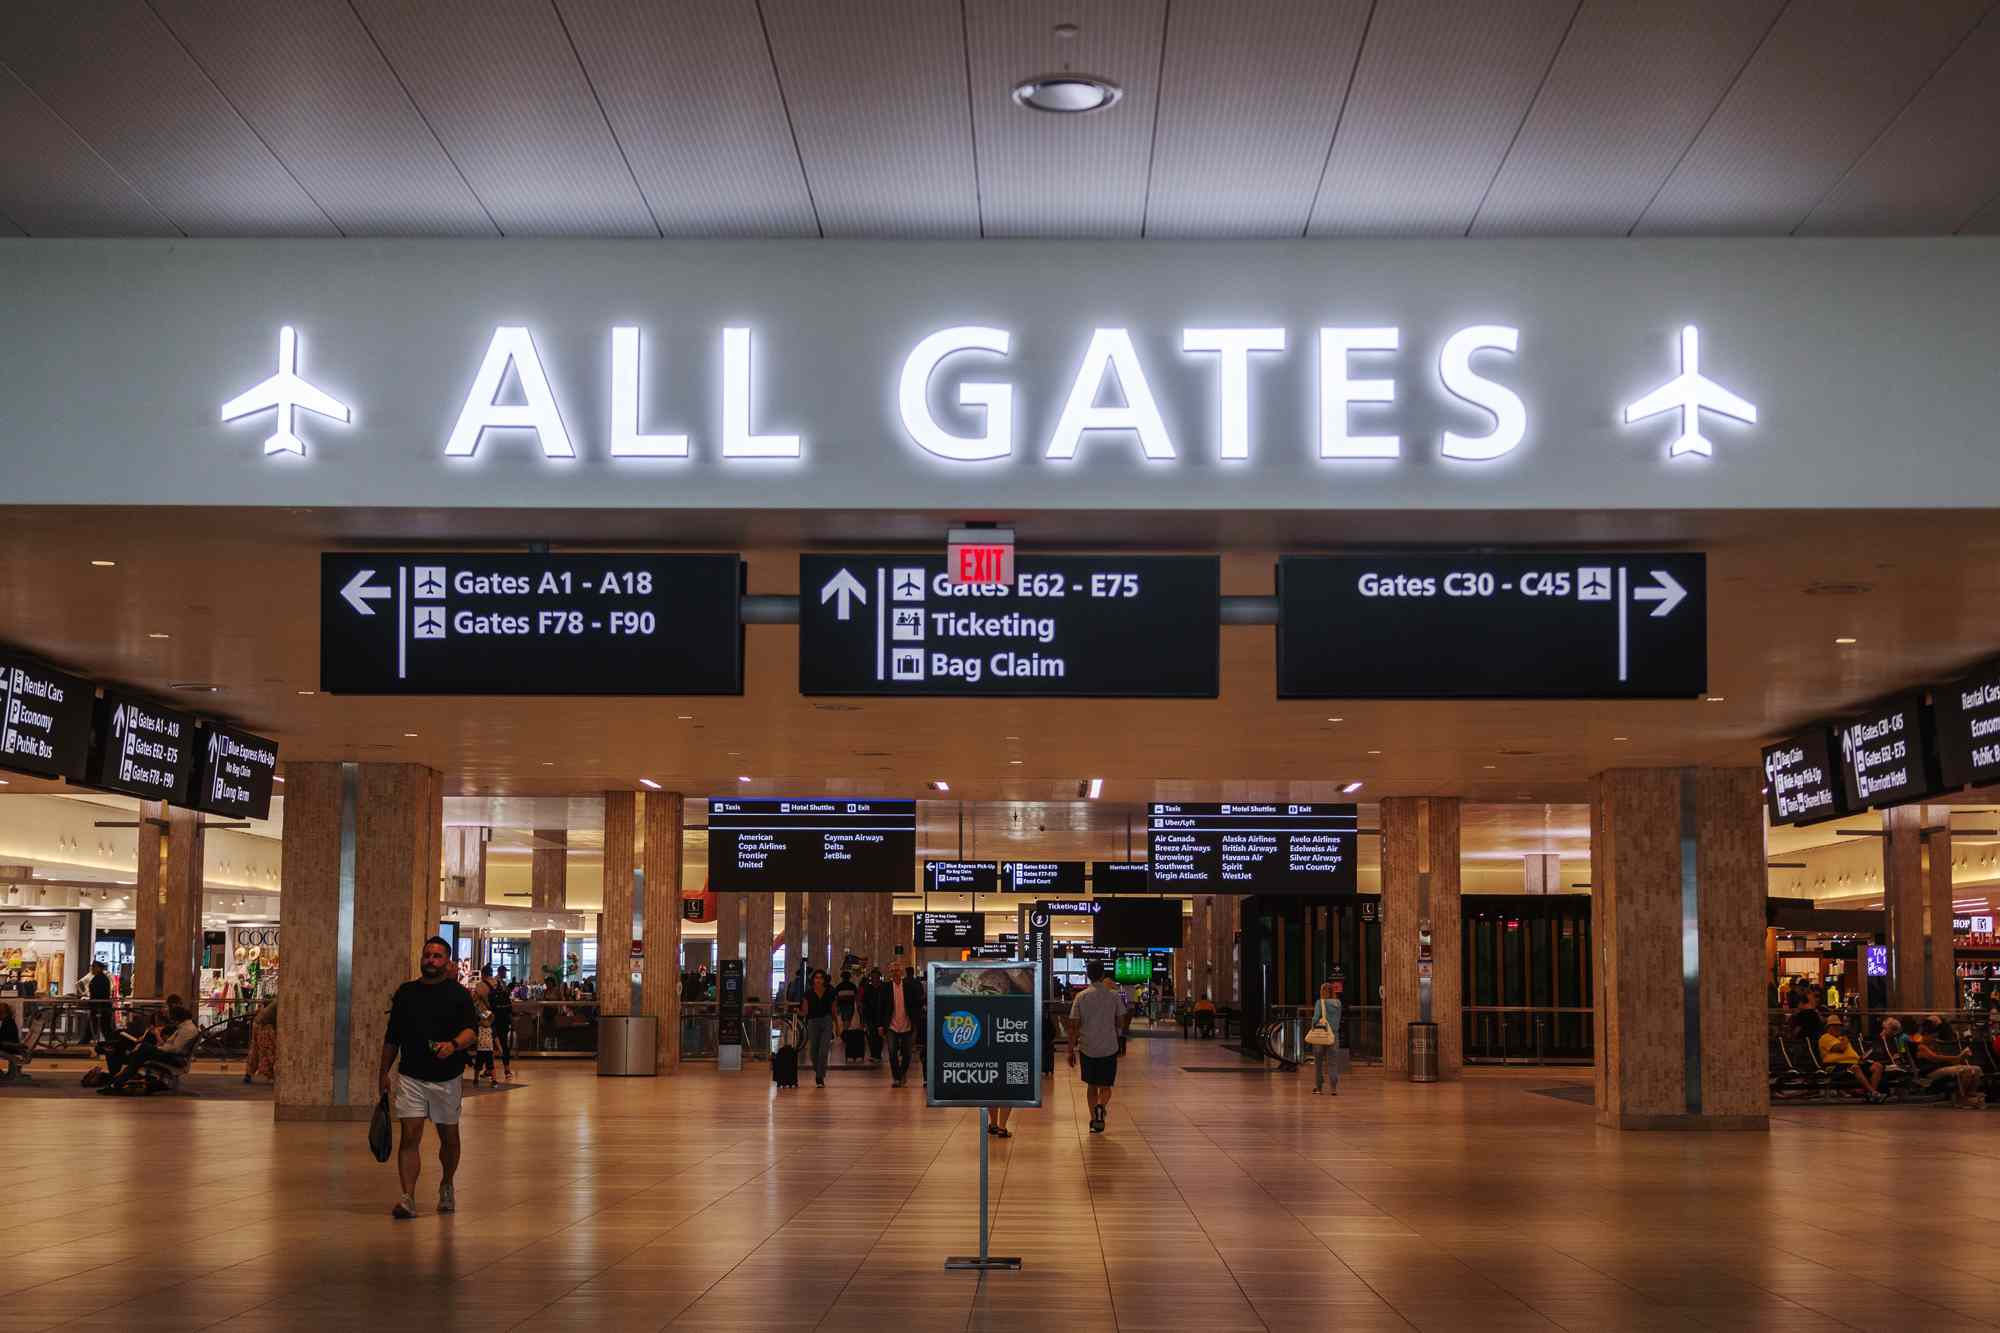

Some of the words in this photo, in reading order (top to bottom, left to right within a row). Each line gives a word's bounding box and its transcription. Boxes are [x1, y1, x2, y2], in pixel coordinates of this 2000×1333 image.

[444, 326, 800, 458] ALL
[899, 325, 1528, 461] GATES
[960, 547, 1004, 582] EXIT
[453, 571, 530, 595] Gates
[537, 571, 573, 594] A1
[600, 571, 653, 594] A18
[932, 573, 1009, 597] Gates
[1018, 574, 1065, 597] E62
[1091, 574, 1139, 597] E75
[1358, 572, 1436, 596] Gates
[1443, 572, 1494, 596] C30
[1519, 572, 1570, 596] C45
[453, 611, 530, 634] Gates
[538, 611, 585, 634] F78
[610, 611, 656, 634] F90
[931, 612, 1056, 642] Ticketing
[932, 653, 983, 682] Bag
[989, 652, 1065, 678] Claim
[23, 676, 48, 697] Rental
[47, 683, 64, 702] Cars
[1961, 686, 1984, 711] Rental
[1984, 684, 2000, 703] Cars
[20, 705, 53, 733] Economy
[138, 712, 155, 731] Gates
[155, 718, 164, 733] A1
[167, 721, 180, 738] A18
[1971, 716, 2000, 737] Econom
[1862, 725, 1879, 741] Gates
[16, 734, 38, 756] Public
[38, 740, 53, 758] Bus
[135, 739, 152, 756] Gates
[152, 743, 164, 760] E62
[167, 747, 178, 763] E75
[228, 740, 240, 756] Blue
[240, 744, 257, 762] Express
[257, 750, 275, 768] Pick-Up
[1864, 750, 1881, 767] Gates
[1972, 745, 1994, 767] Public
[132, 765, 149, 782] Gates
[149, 769, 160, 785] F78
[163, 772, 174, 788] F90
[223, 783, 236, 803] Long
[724, 803, 741, 811] Taxis
[1164, 819, 1196, 827] Uber/Lyft
[738, 833, 773, 841] American
[824, 833, 854, 842] Cayman
[854, 833, 884, 842] Airways
[1222, 835, 1247, 843] Alaska
[1247, 835, 1276, 843] Airlines
[738, 843, 757, 852] Copa
[1155, 844, 1180, 852] Breeze
[1181, 844, 1211, 853] Airways
[1222, 844, 1247, 852] British
[1247, 845, 1278, 854] Airways
[823, 852, 852, 860] JetBlue
[1155, 853, 1193, 862] Eurowings
[1289, 854, 1311, 862] Silver
[1312, 854, 1342, 863] Airways
[738, 861, 763, 869] United
[1222, 863, 1243, 871] Spirit
[1289, 863, 1304, 871] Sun
[1305, 863, 1336, 873] Country
[1154, 872, 1178, 880] Virgin
[1222, 872, 1252, 880] WestJet
[1047, 902, 1078, 911] Ticketing
[1952, 919, 1970, 928] HOP
[944, 1015, 976, 1032] TPA
[996, 1017, 1028, 1029] Uber
[996, 1030, 1029, 1043] Eats
[943, 1069, 999, 1084] PICKUP
